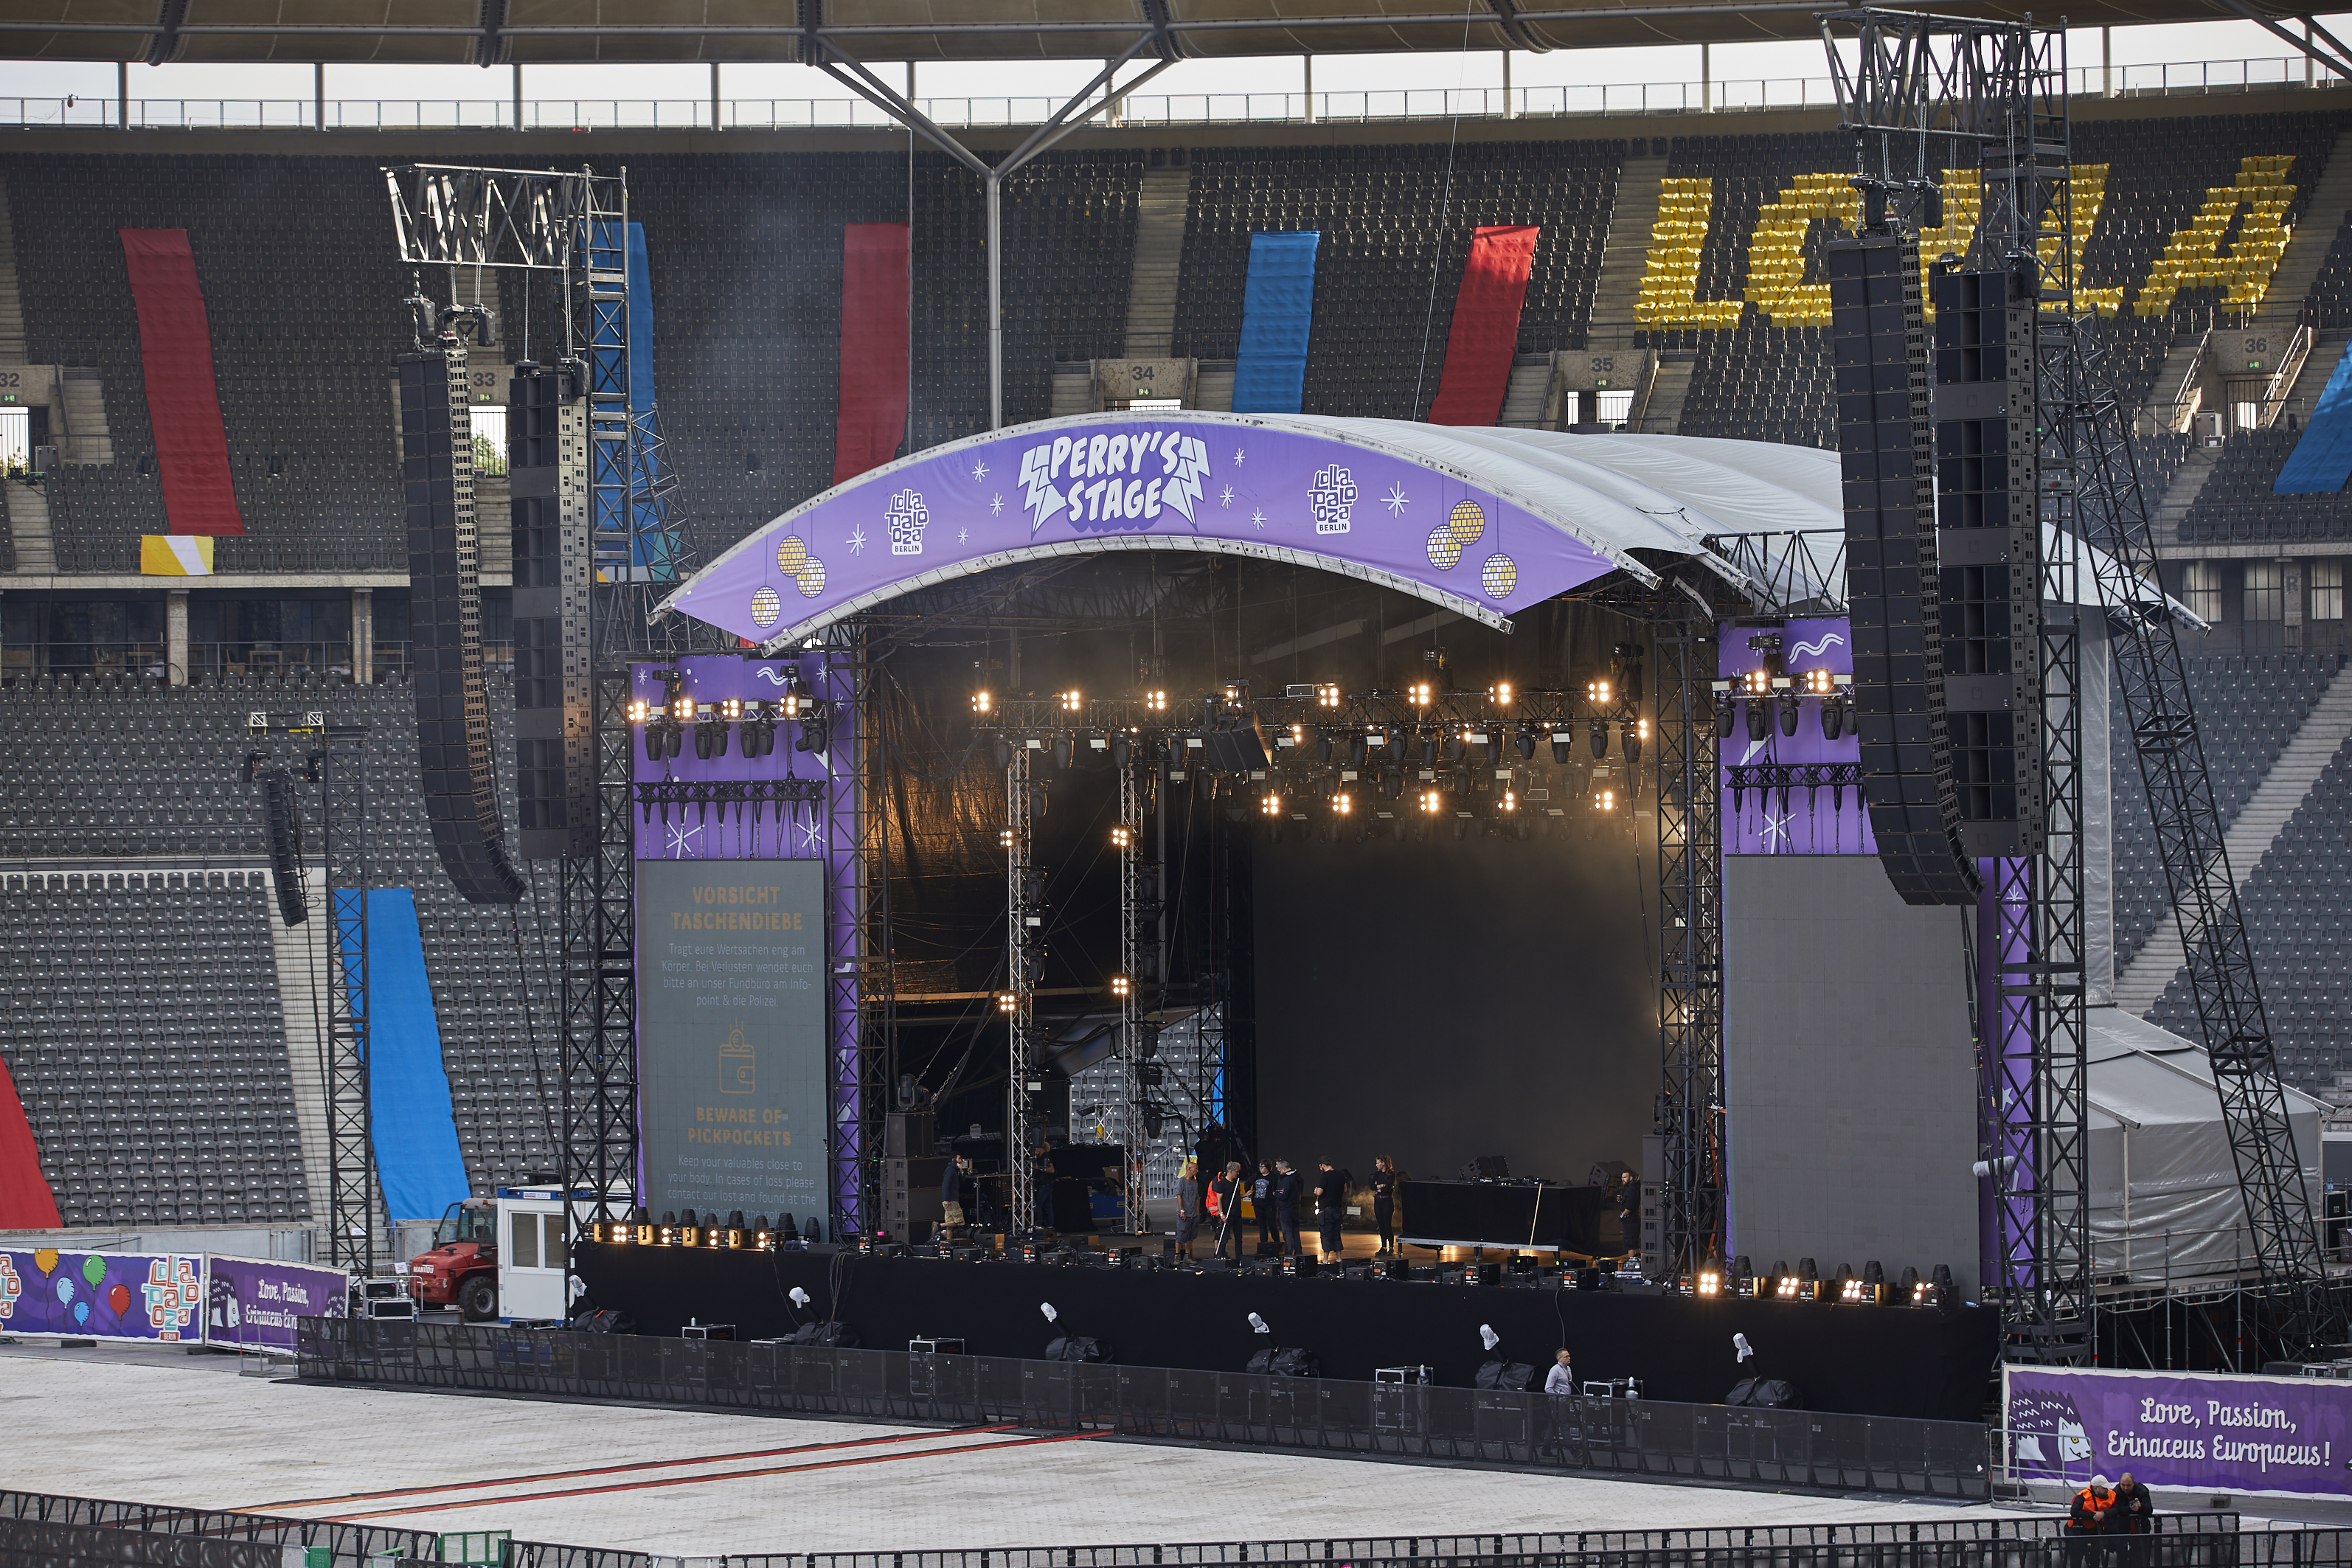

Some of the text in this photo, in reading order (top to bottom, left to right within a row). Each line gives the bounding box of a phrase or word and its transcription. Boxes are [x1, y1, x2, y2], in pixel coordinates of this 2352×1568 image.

[2244, 338, 2267, 353] 36
[1131, 366, 1155, 381] 34
[1591, 358, 1614, 373] 35
[0, 372, 20, 387] 32
[473, 372, 496, 387] 33
[1050, 431, 1181, 479] PERRY'S
[1067, 477, 1162, 521] STAGE
[1319, 523, 1347, 532] BERLIN
[2286, 575, 2299, 592] R
[692, 887, 780, 904] VORSICHT
[671, 912, 802, 930] TASCHENDIEBE
[669, 943, 805, 958] Tragt eure Wertsachen eng am
[662, 960, 813, 973] Körper. Bei Verlusten wendet euch
[663, 977, 812, 990] bitte an unser Fundbüro am Info-
[696, 995, 779, 1007] point & die Polizei.
[696, 1106, 782, 1125] BEWARE OF
[688, 1128, 791, 1147] PICKPOCKETS
[679, 1154, 803, 1171] Keep your valuables close to
[668, 1172, 814, 1190] your body. In cases of loss please
[667, 1189, 816, 1205] contact our lost and found at the
[413, 1264, 434, 1274] MANITOU
[258, 1278, 309, 1308] Love, Passion,
[2140, 1397, 2297, 1435] Love, Passion,
[2108, 1429, 2206, 1461] Erinaceus
